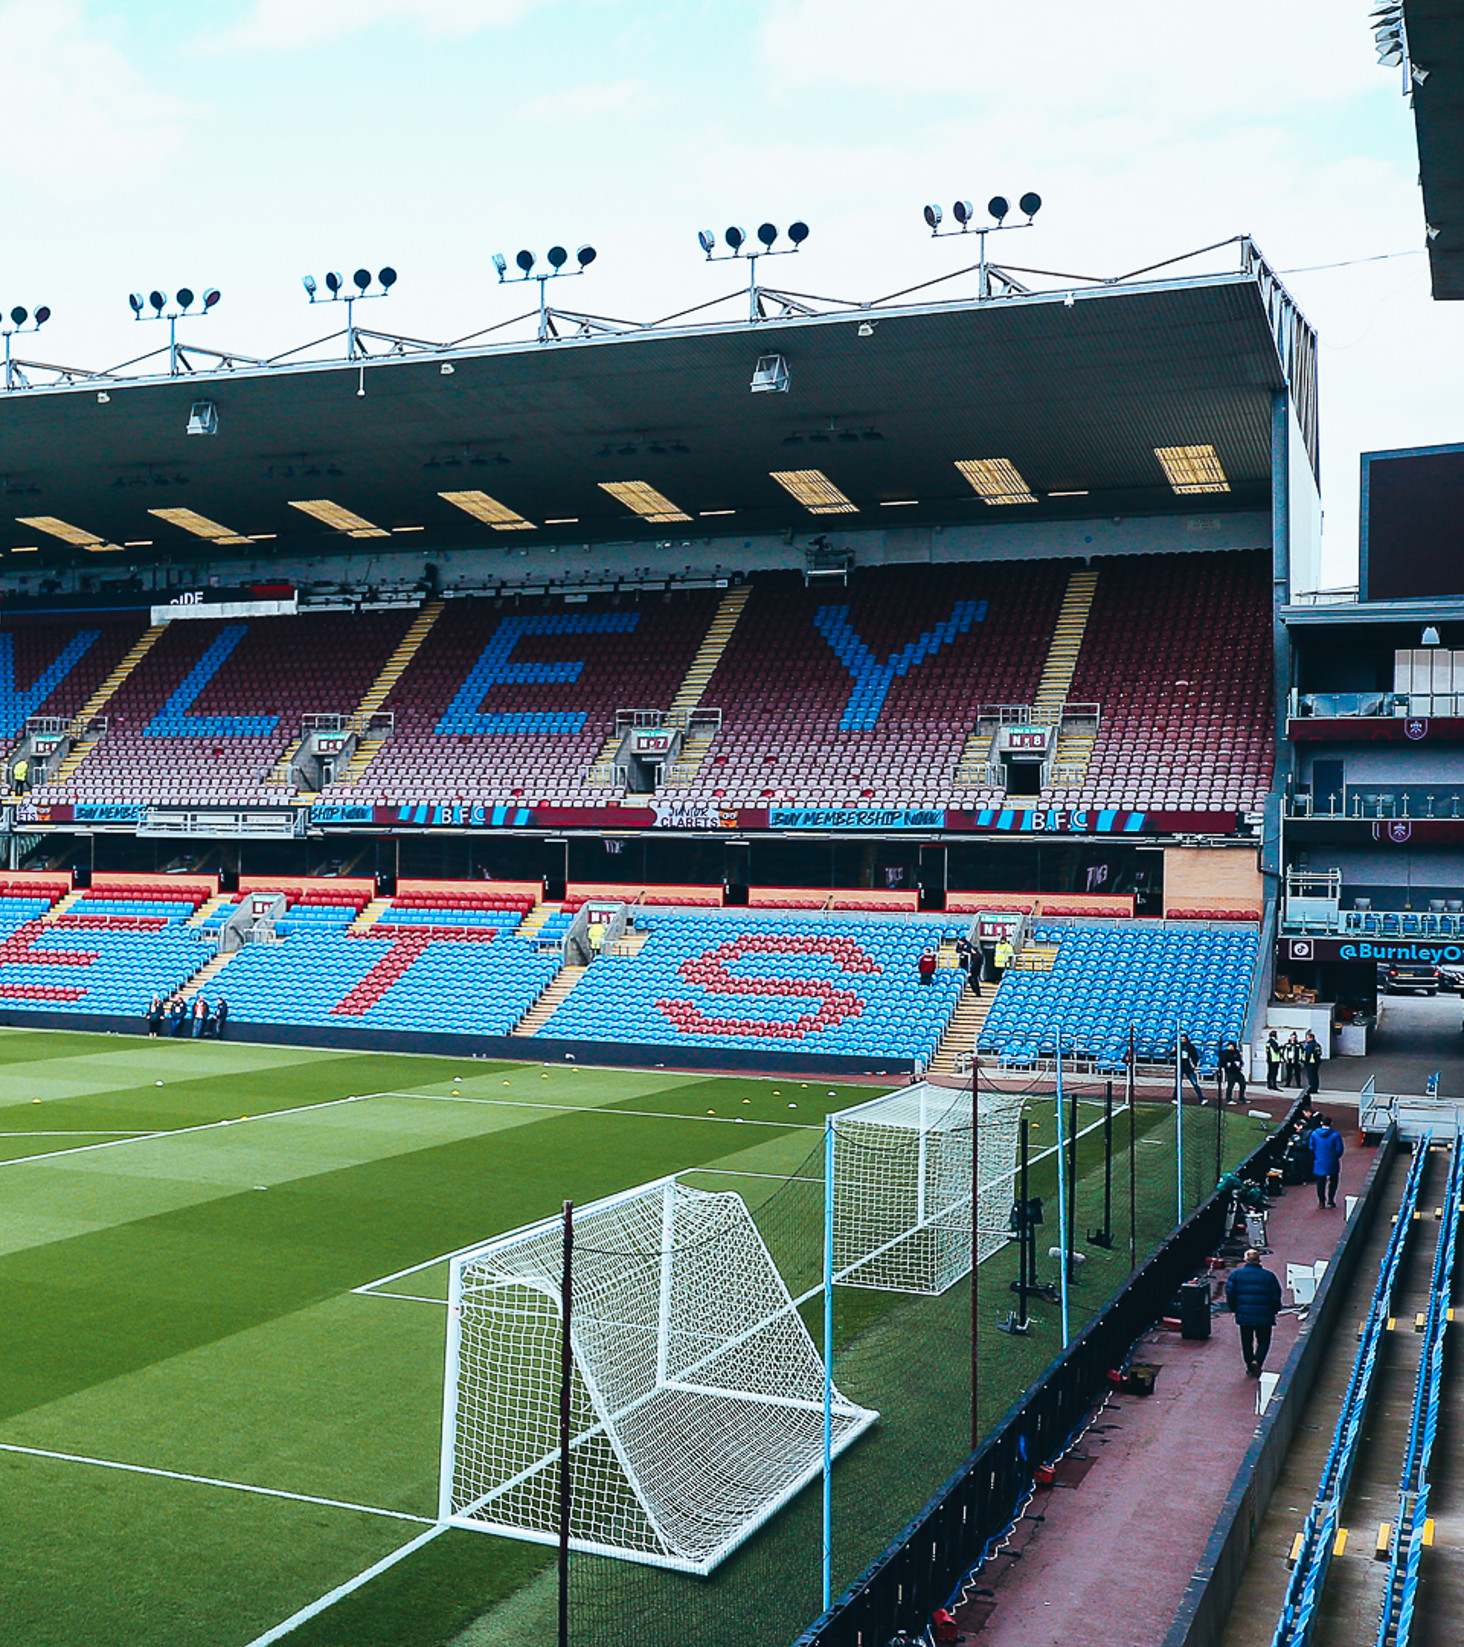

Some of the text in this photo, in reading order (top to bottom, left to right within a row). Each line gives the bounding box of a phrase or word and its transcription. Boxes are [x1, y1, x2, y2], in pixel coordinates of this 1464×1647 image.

[661, 817, 718, 828] CLARETS
[771, 811, 803, 826] BUY
[803, 810, 902, 826] MEMBERSHIP
[1340, 943, 1464, 964] @BurnleyO
